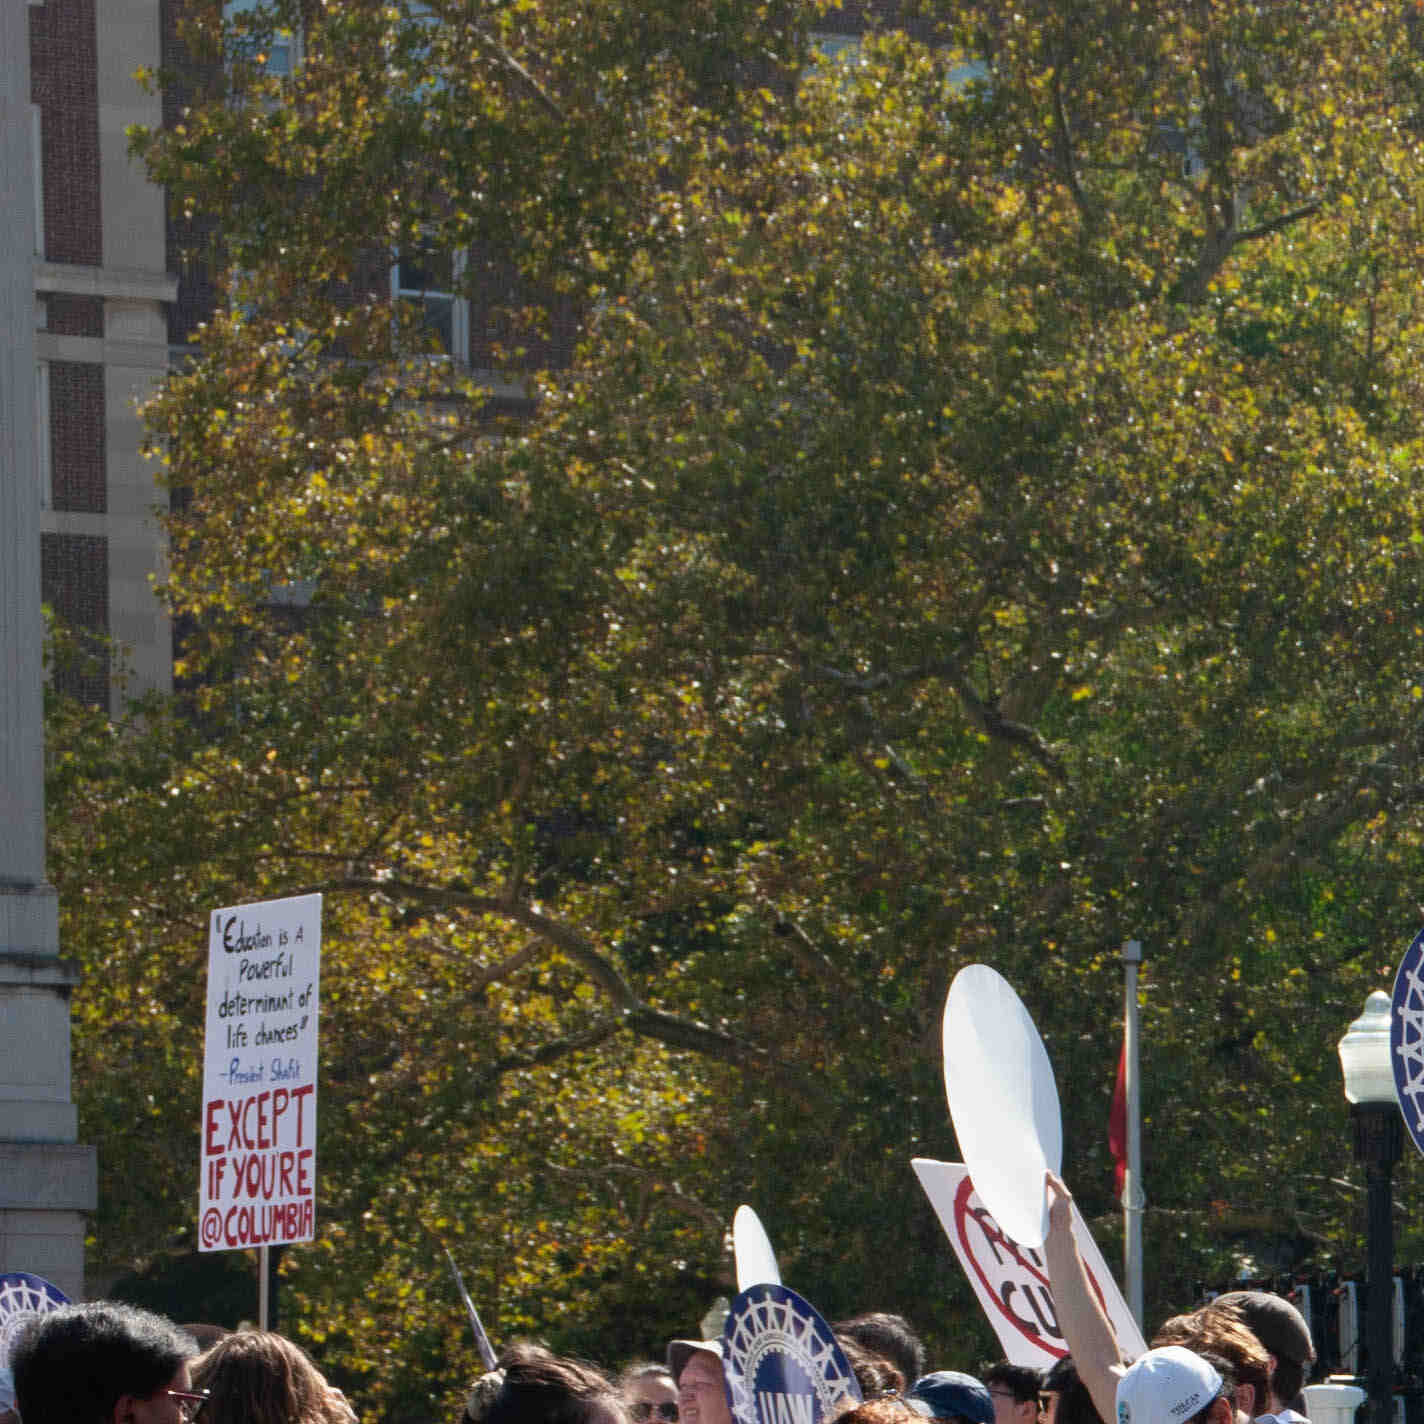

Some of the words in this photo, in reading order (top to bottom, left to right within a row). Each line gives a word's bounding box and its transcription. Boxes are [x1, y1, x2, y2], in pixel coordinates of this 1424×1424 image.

[240, 952, 293, 984] Powerful
[298, 983, 313, 1009] of
[226, 1023, 249, 1049] life
[205, 1083, 314, 1157] EXCEPT
[208, 1157, 227, 1200] IF
[232, 1149, 313, 1200] YOU'RE
[201, 1199, 313, 1249] @COLUMBIA
